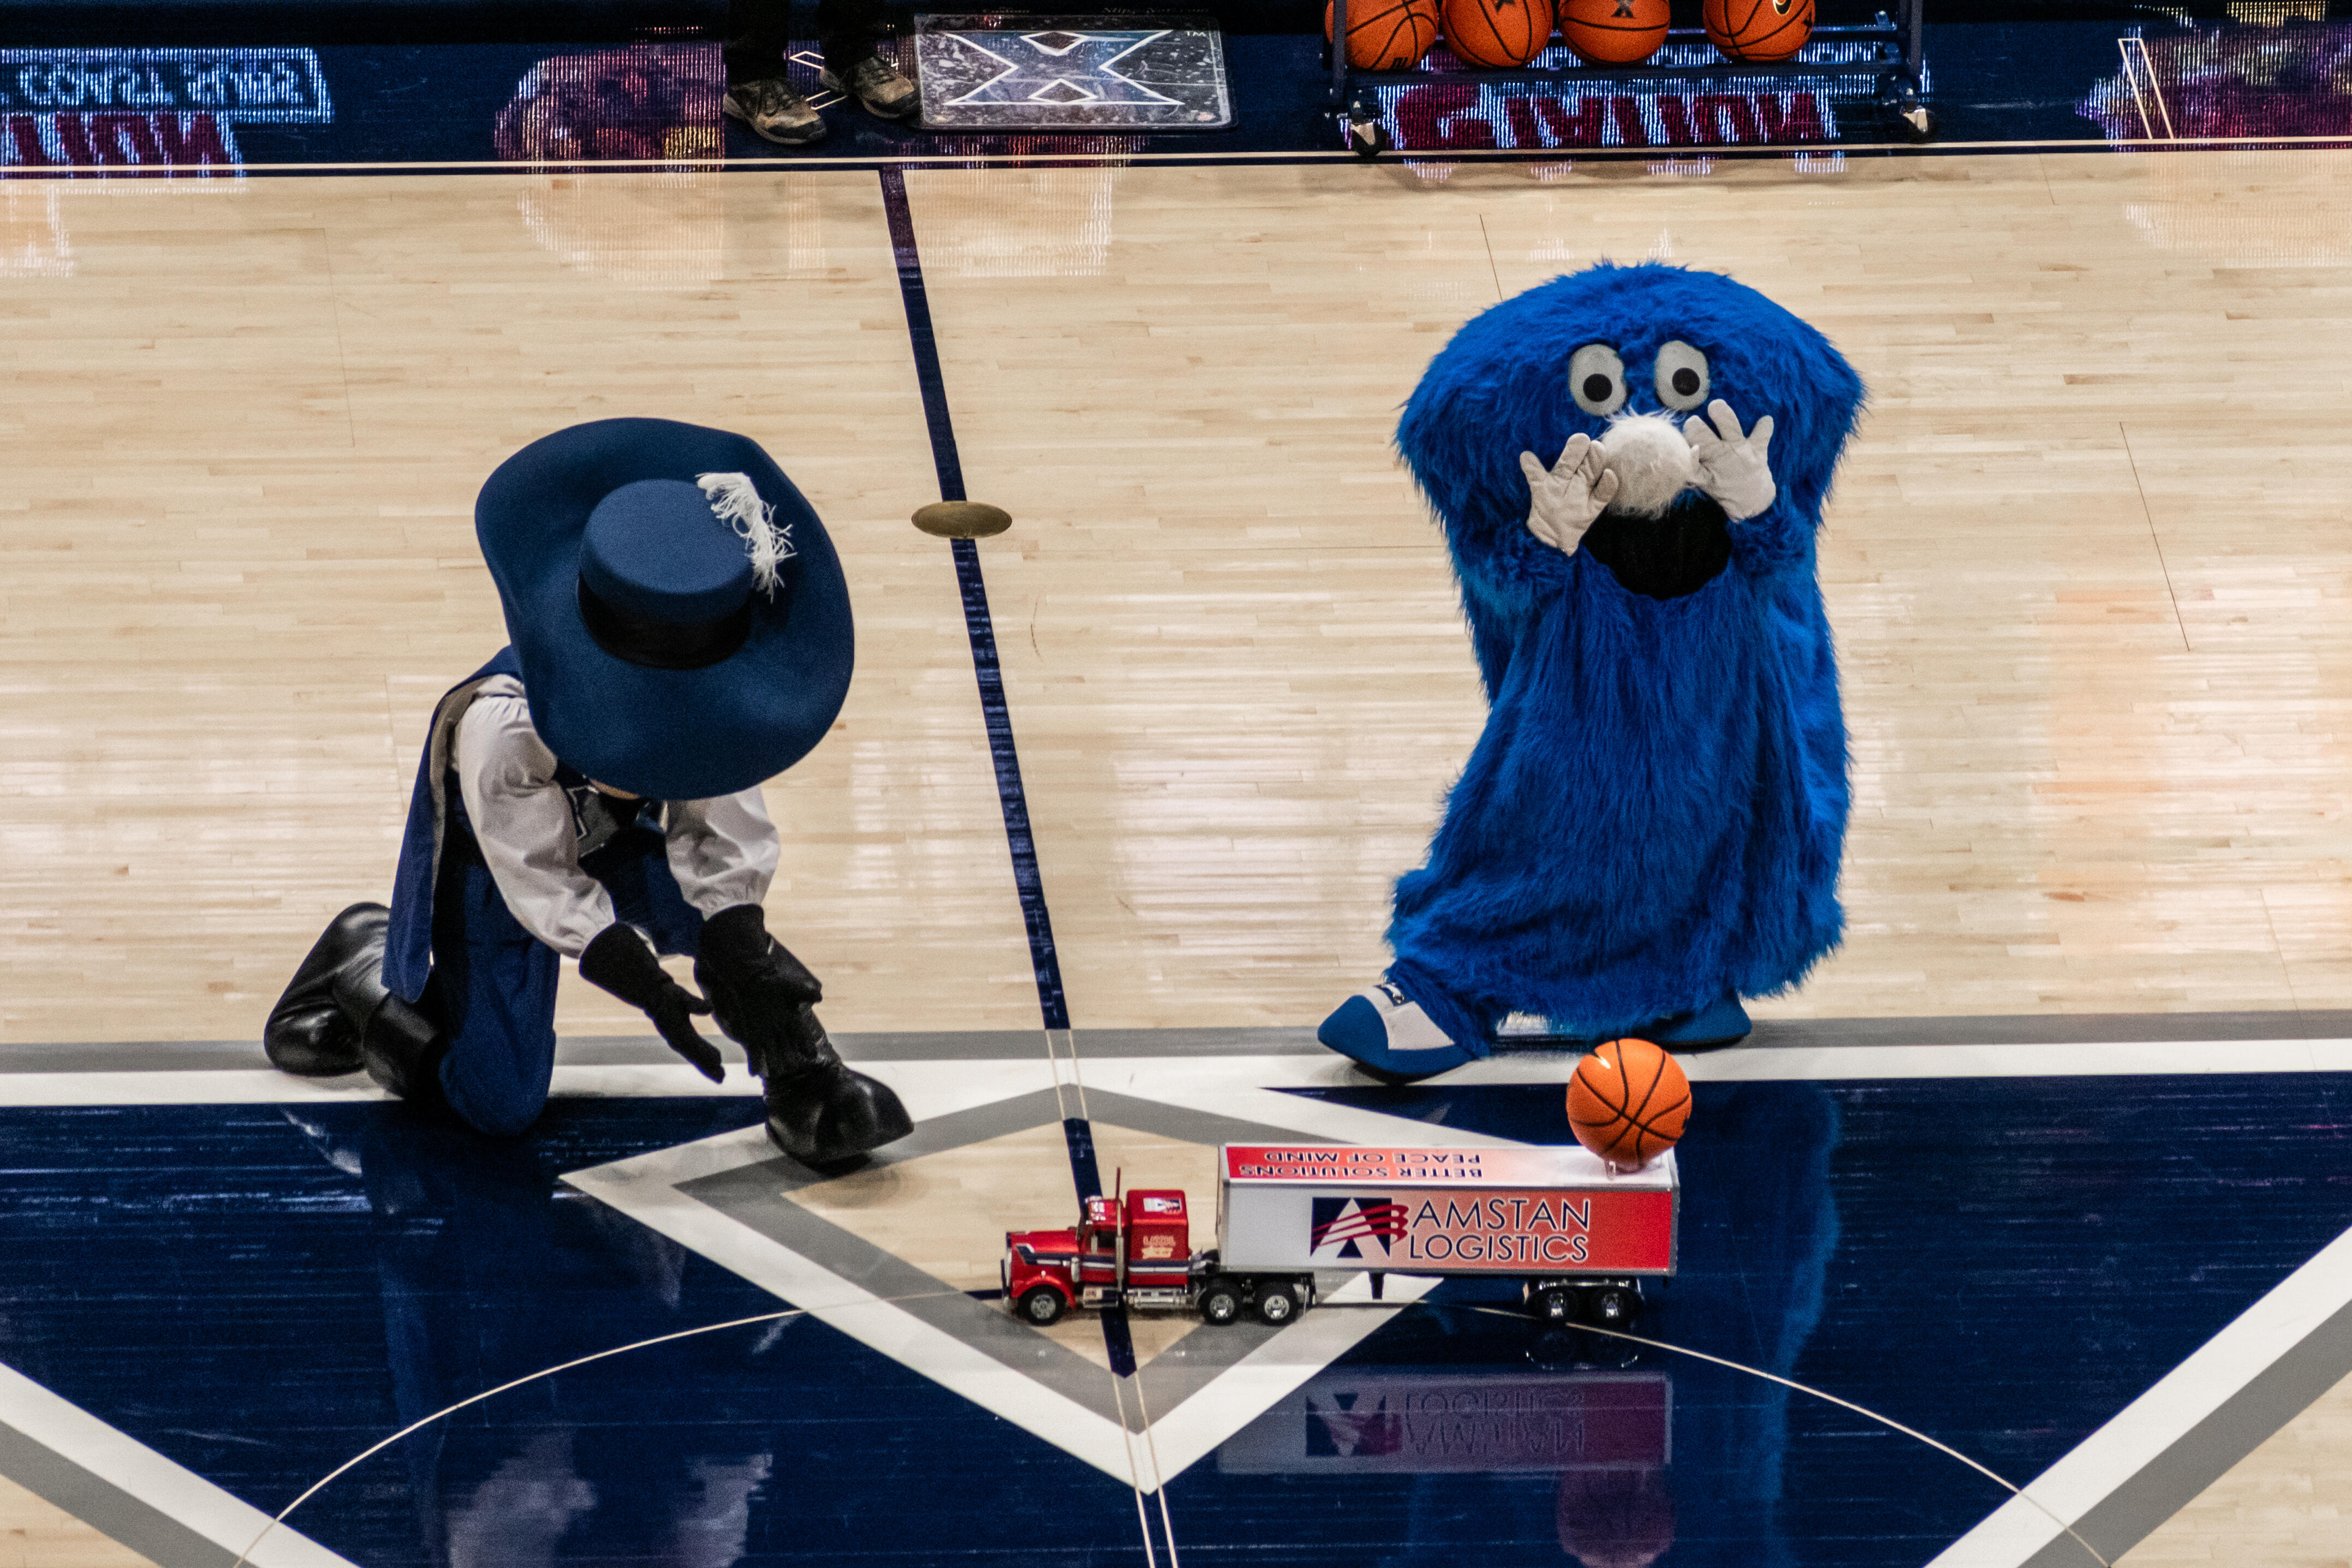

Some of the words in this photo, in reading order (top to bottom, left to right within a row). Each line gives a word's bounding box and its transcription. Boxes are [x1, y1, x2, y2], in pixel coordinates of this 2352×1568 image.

[1265, 1151, 1339, 1162] MIND
[1347, 1153, 1384, 1164] OF
[1394, 1153, 1480, 1164] PEACE
[1240, 1165, 1389, 1177] SOLUTIONS
[1399, 1167, 1483, 1178] BETTER
[1412, 1199, 1591, 1230] AMSTAN
[1410, 1235, 1588, 1261] LOGISTICS
